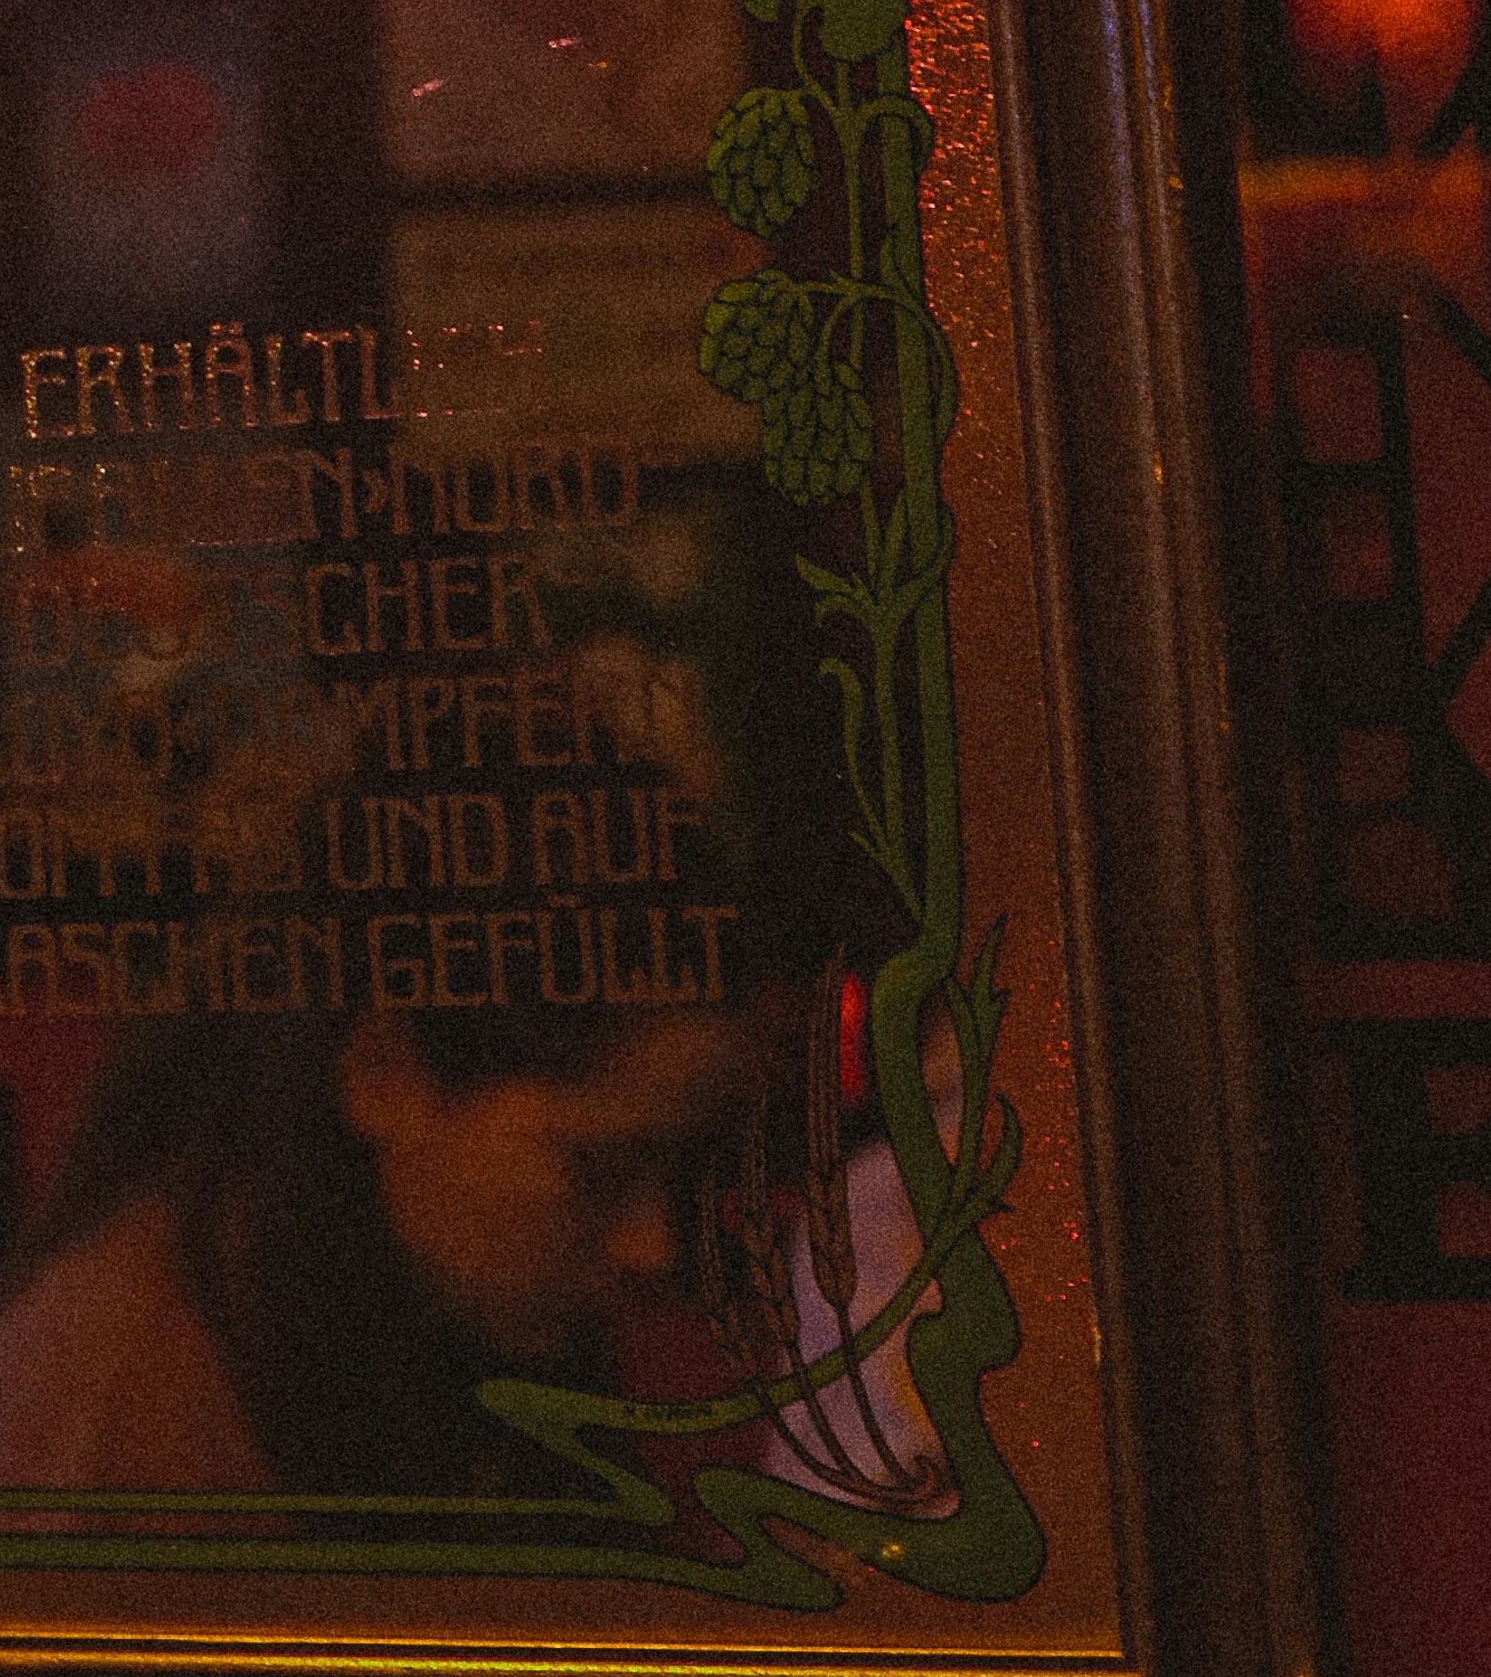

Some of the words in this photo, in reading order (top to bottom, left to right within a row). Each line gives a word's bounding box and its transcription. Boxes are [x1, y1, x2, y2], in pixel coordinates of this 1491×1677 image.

[325, 793, 509, 891] UND
[532, 786, 707, 885] AUF
[366, 896, 740, 1010] GEFÜLLT
